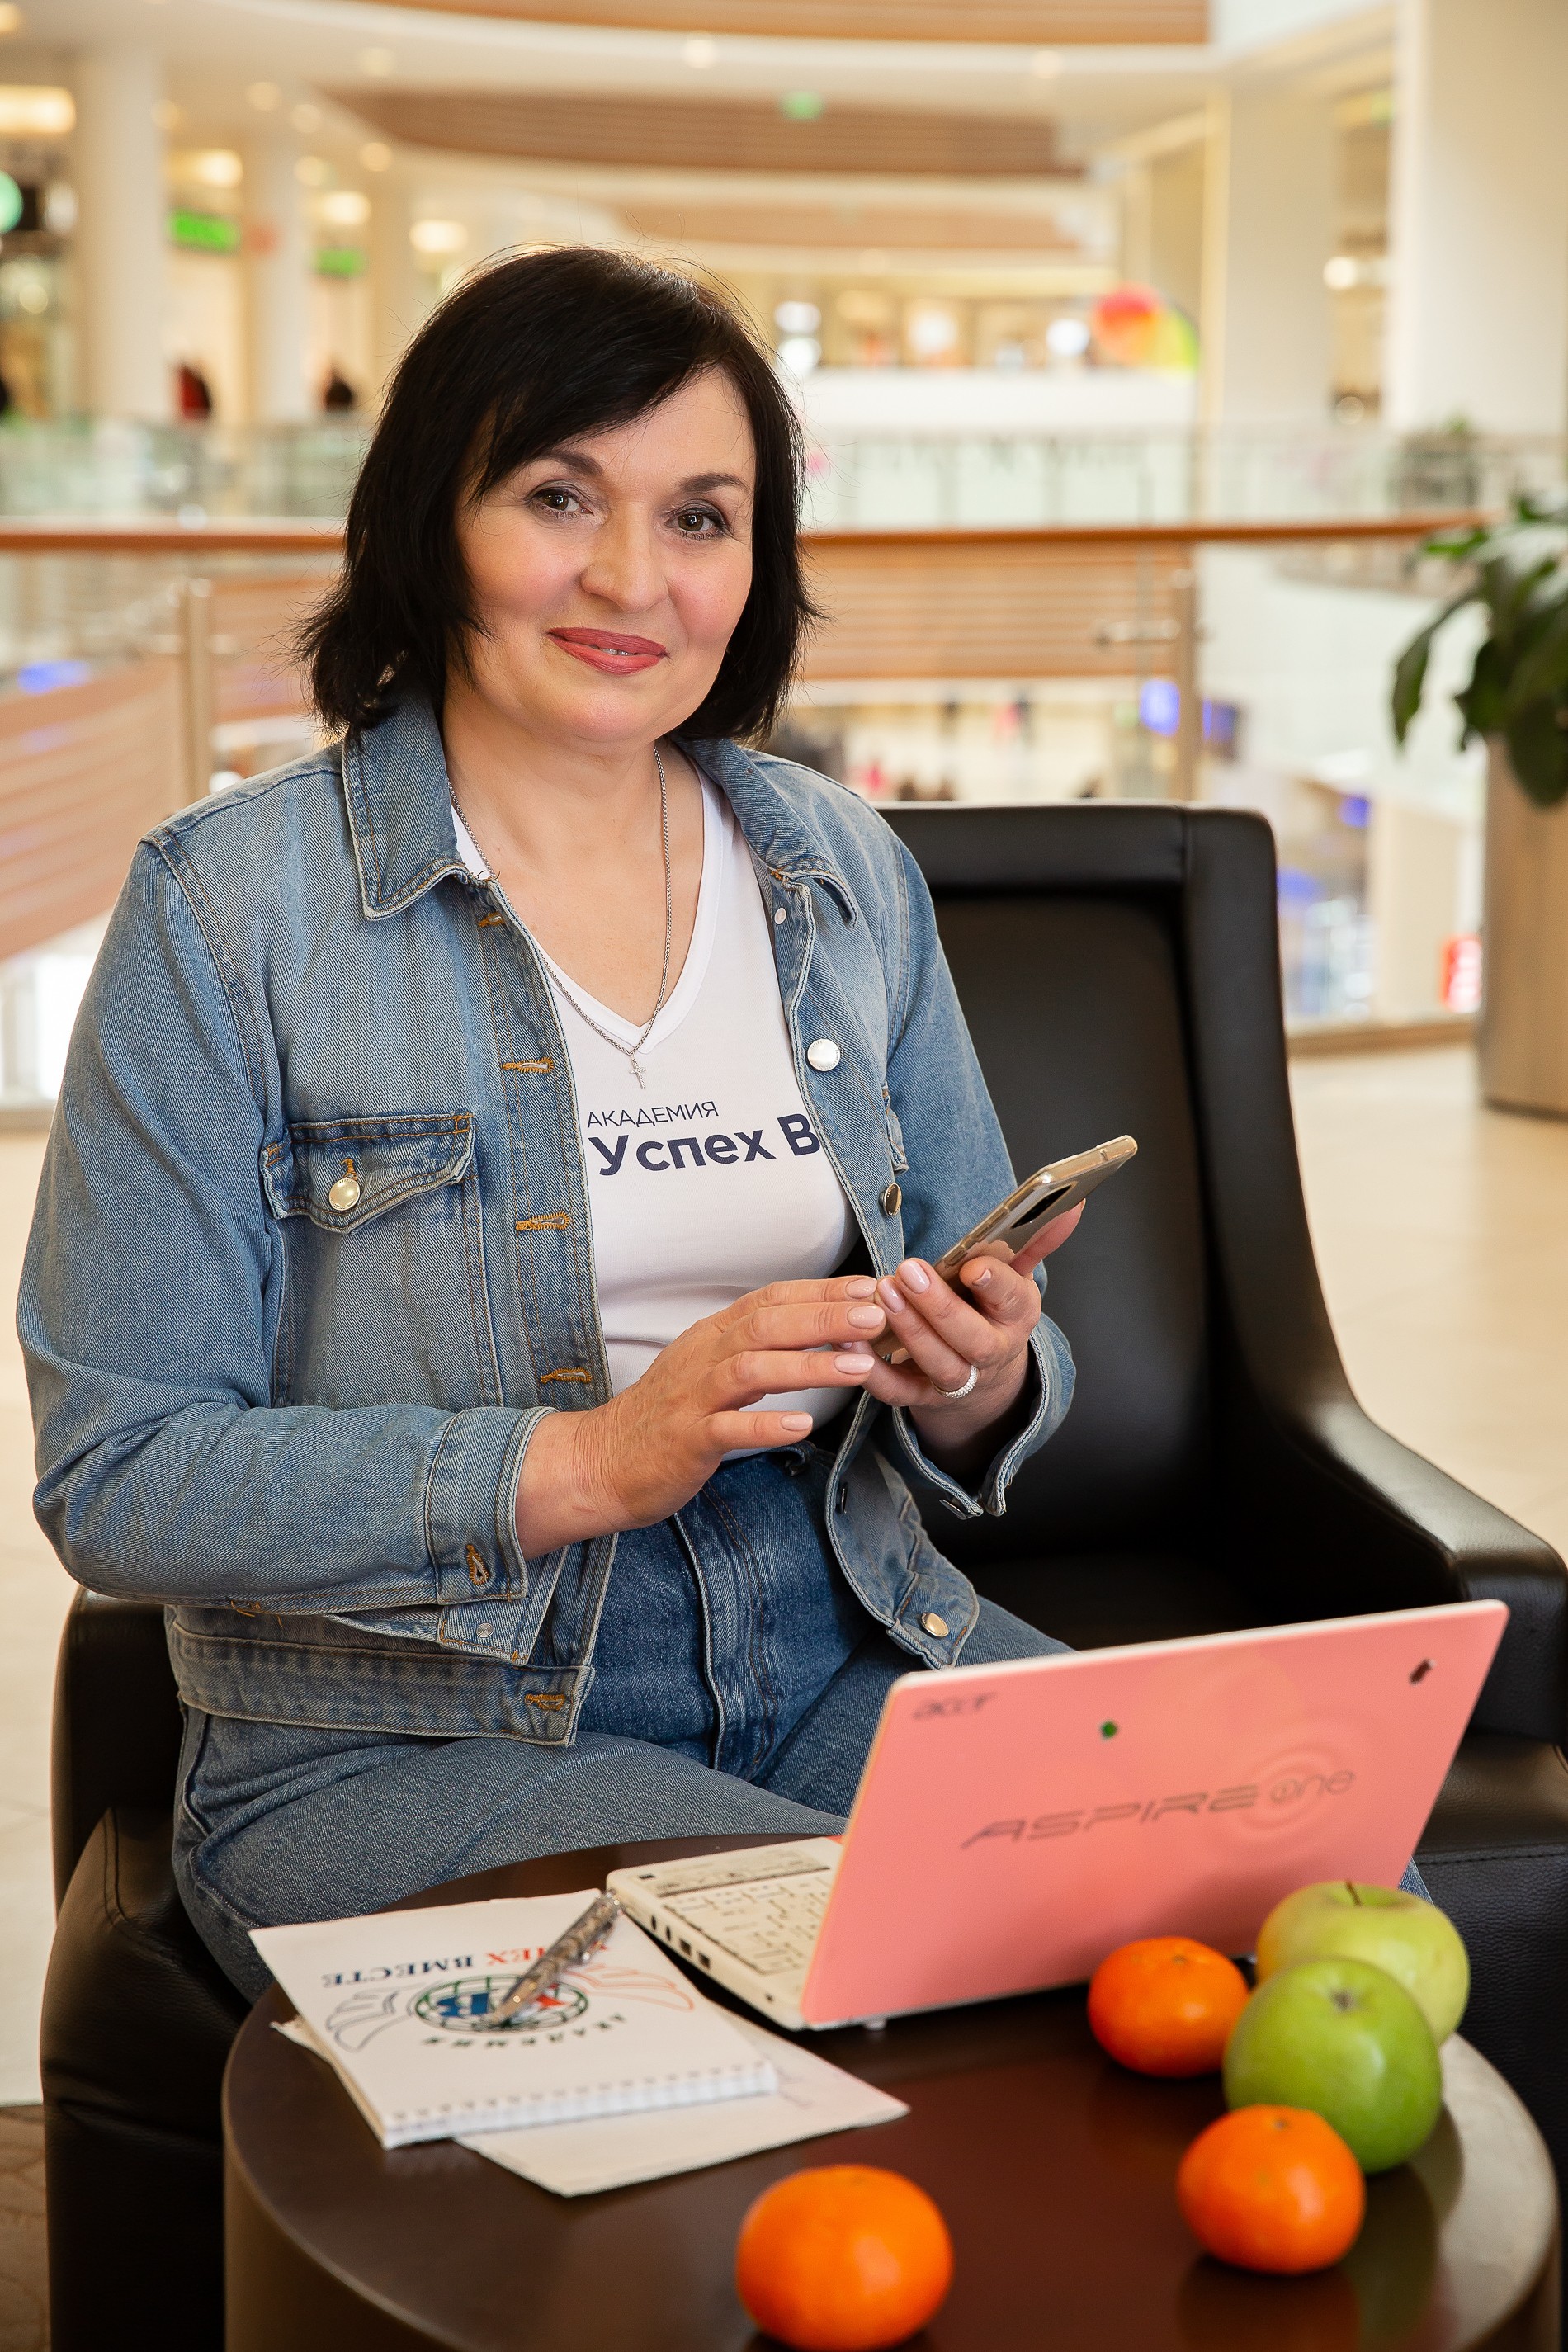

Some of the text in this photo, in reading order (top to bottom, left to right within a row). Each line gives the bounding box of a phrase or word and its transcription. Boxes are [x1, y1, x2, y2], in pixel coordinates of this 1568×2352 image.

[587, 1101, 719, 1128] АКАДЕМИЯ
[588, 1129, 777, 1176] Успех
[960, 1784, 1258, 1849] ASPIRE
